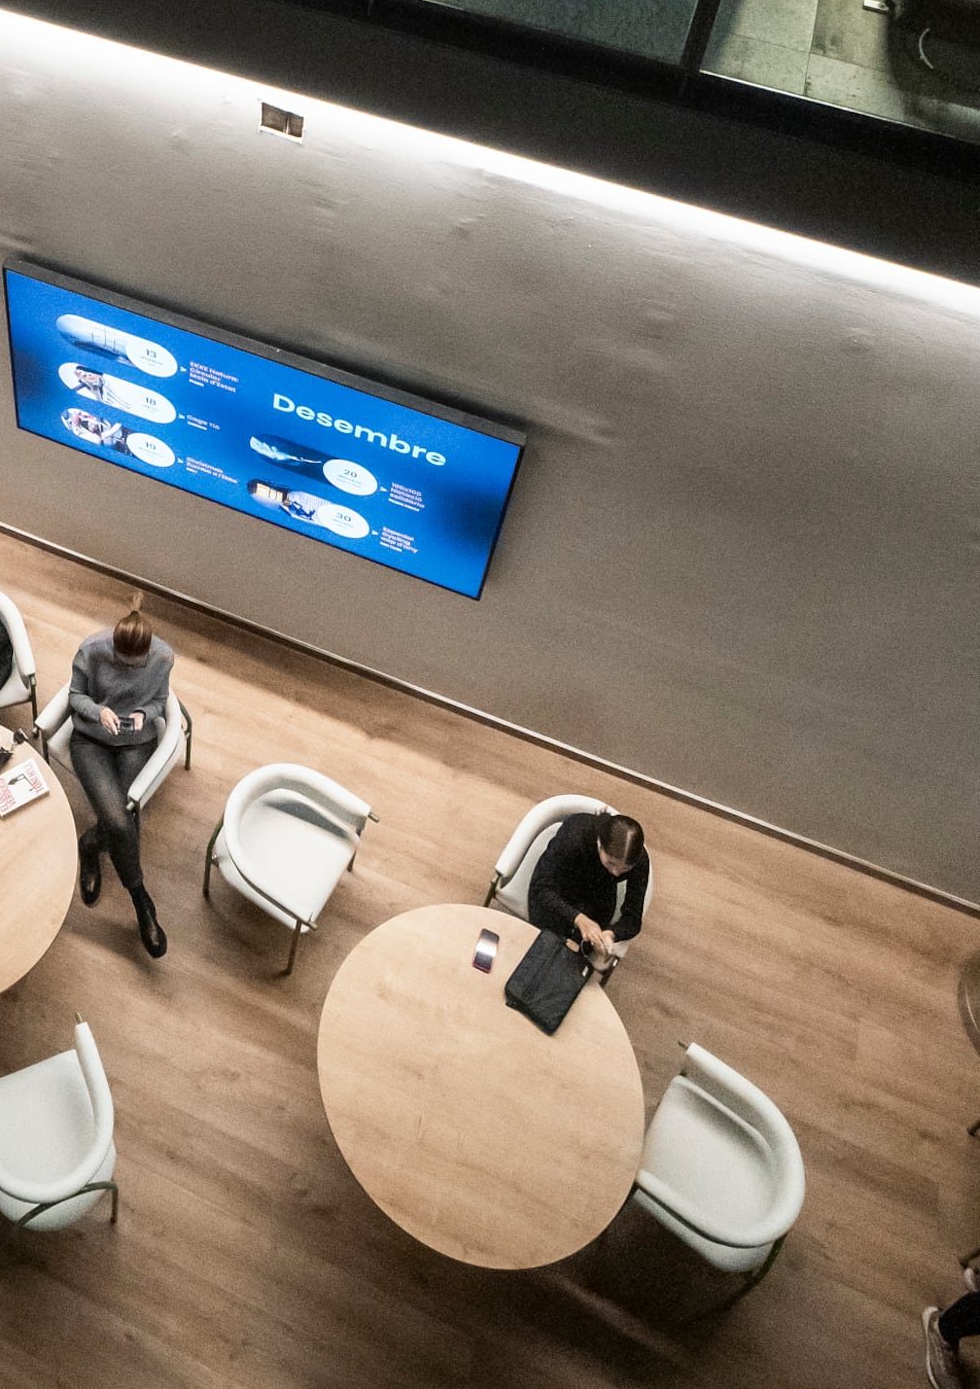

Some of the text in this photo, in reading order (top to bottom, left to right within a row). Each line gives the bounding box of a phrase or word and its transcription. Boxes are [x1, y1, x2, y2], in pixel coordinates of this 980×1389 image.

[145, 397, 157, 406] 18
[273, 393, 446, 466] Desembre
[343, 469, 357, 478] 20
[336, 512, 351, 522] 30
